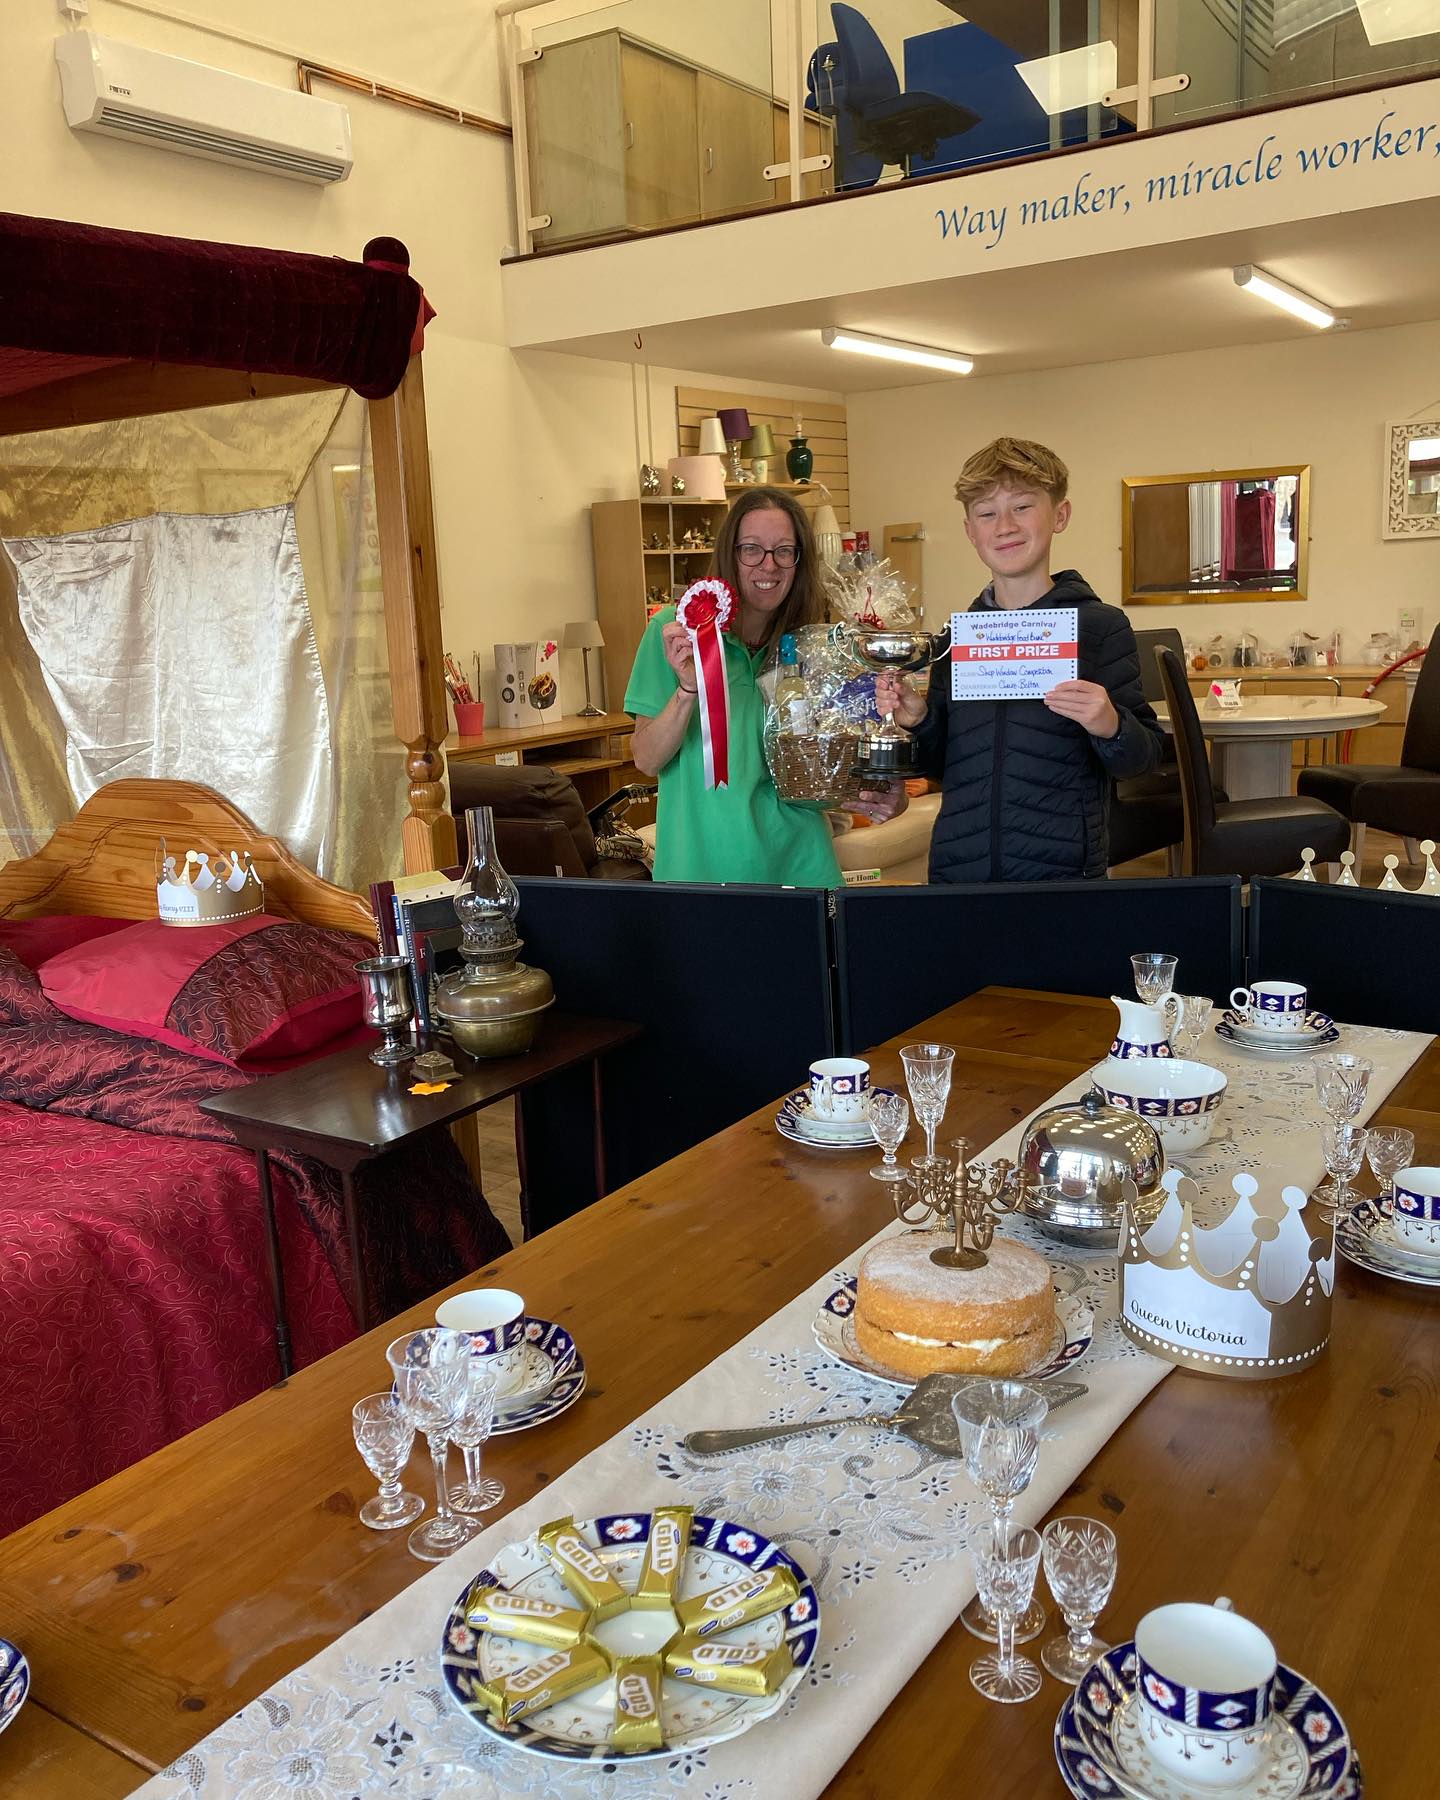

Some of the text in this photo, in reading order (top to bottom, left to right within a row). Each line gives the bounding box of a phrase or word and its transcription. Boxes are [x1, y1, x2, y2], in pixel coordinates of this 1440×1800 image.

[935, 112, 1440, 249] Way maker, miracle worker,
[971, 620, 1057, 630] Wadebridge Carnival
[969, 645, 1060, 658] FIRST PRIZE
[1130, 1299, 1247, 1346] Queen Victoria
[559, 1539, 606, 1580] GOLD
[656, 1523, 674, 1570] GOLD
[493, 1597, 556, 1613] GOLD
[709, 1571, 769, 1608] GOLD
[511, 1653, 567, 1689] GOLD
[698, 1646, 761, 1659] GOLD
[624, 1677, 651, 1715] GOLD
